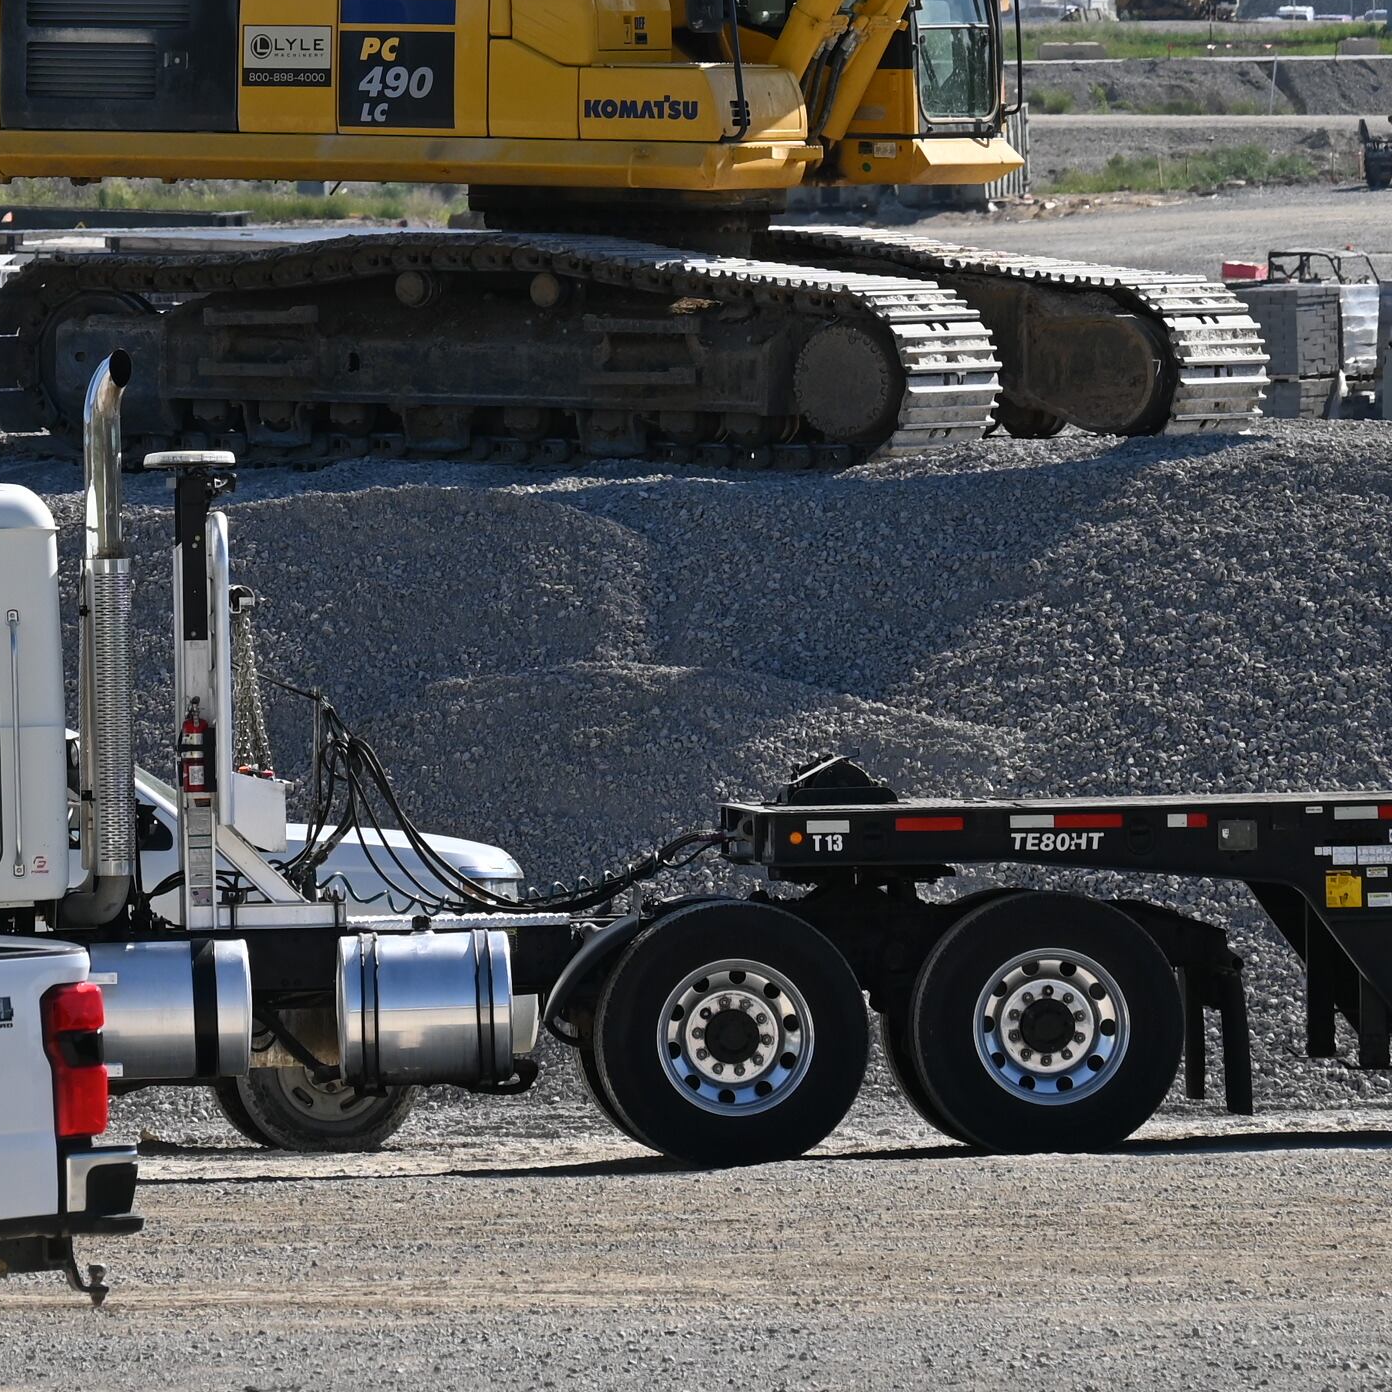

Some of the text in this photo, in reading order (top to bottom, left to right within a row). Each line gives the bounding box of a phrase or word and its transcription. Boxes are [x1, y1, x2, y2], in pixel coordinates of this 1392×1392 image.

[274, 38, 325, 51] LYLE
[359, 37, 400, 61] PC
[248, 72, 326, 82] 800-898-4000
[358, 66, 434, 99] 490
[360, 102, 389, 122] LC
[584, 95, 698, 119] KOMATSU
[813, 834, 843, 851] T 13
